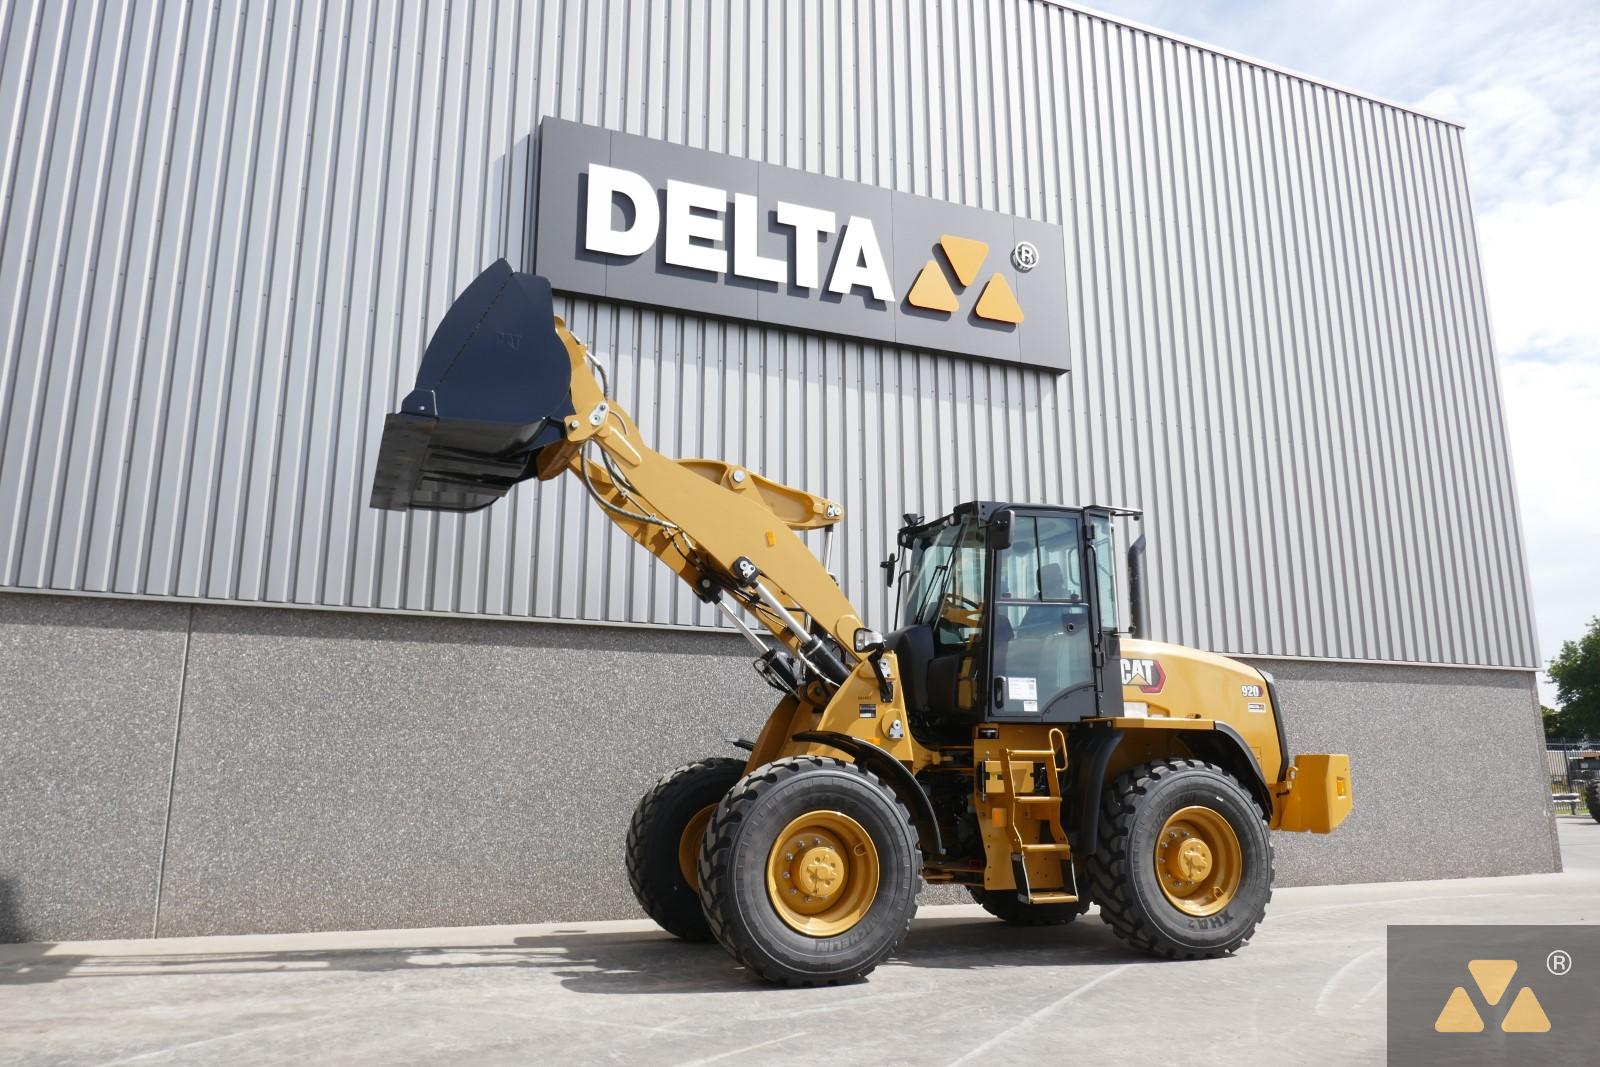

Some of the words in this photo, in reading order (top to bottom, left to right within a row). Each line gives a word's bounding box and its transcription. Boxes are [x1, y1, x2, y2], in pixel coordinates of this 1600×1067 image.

[585, 163, 896, 302] DELTA
[1120, 658, 1154, 686] CAT
[1241, 685, 1259, 697] 920
[815, 911, 882, 953] MICHELIN
